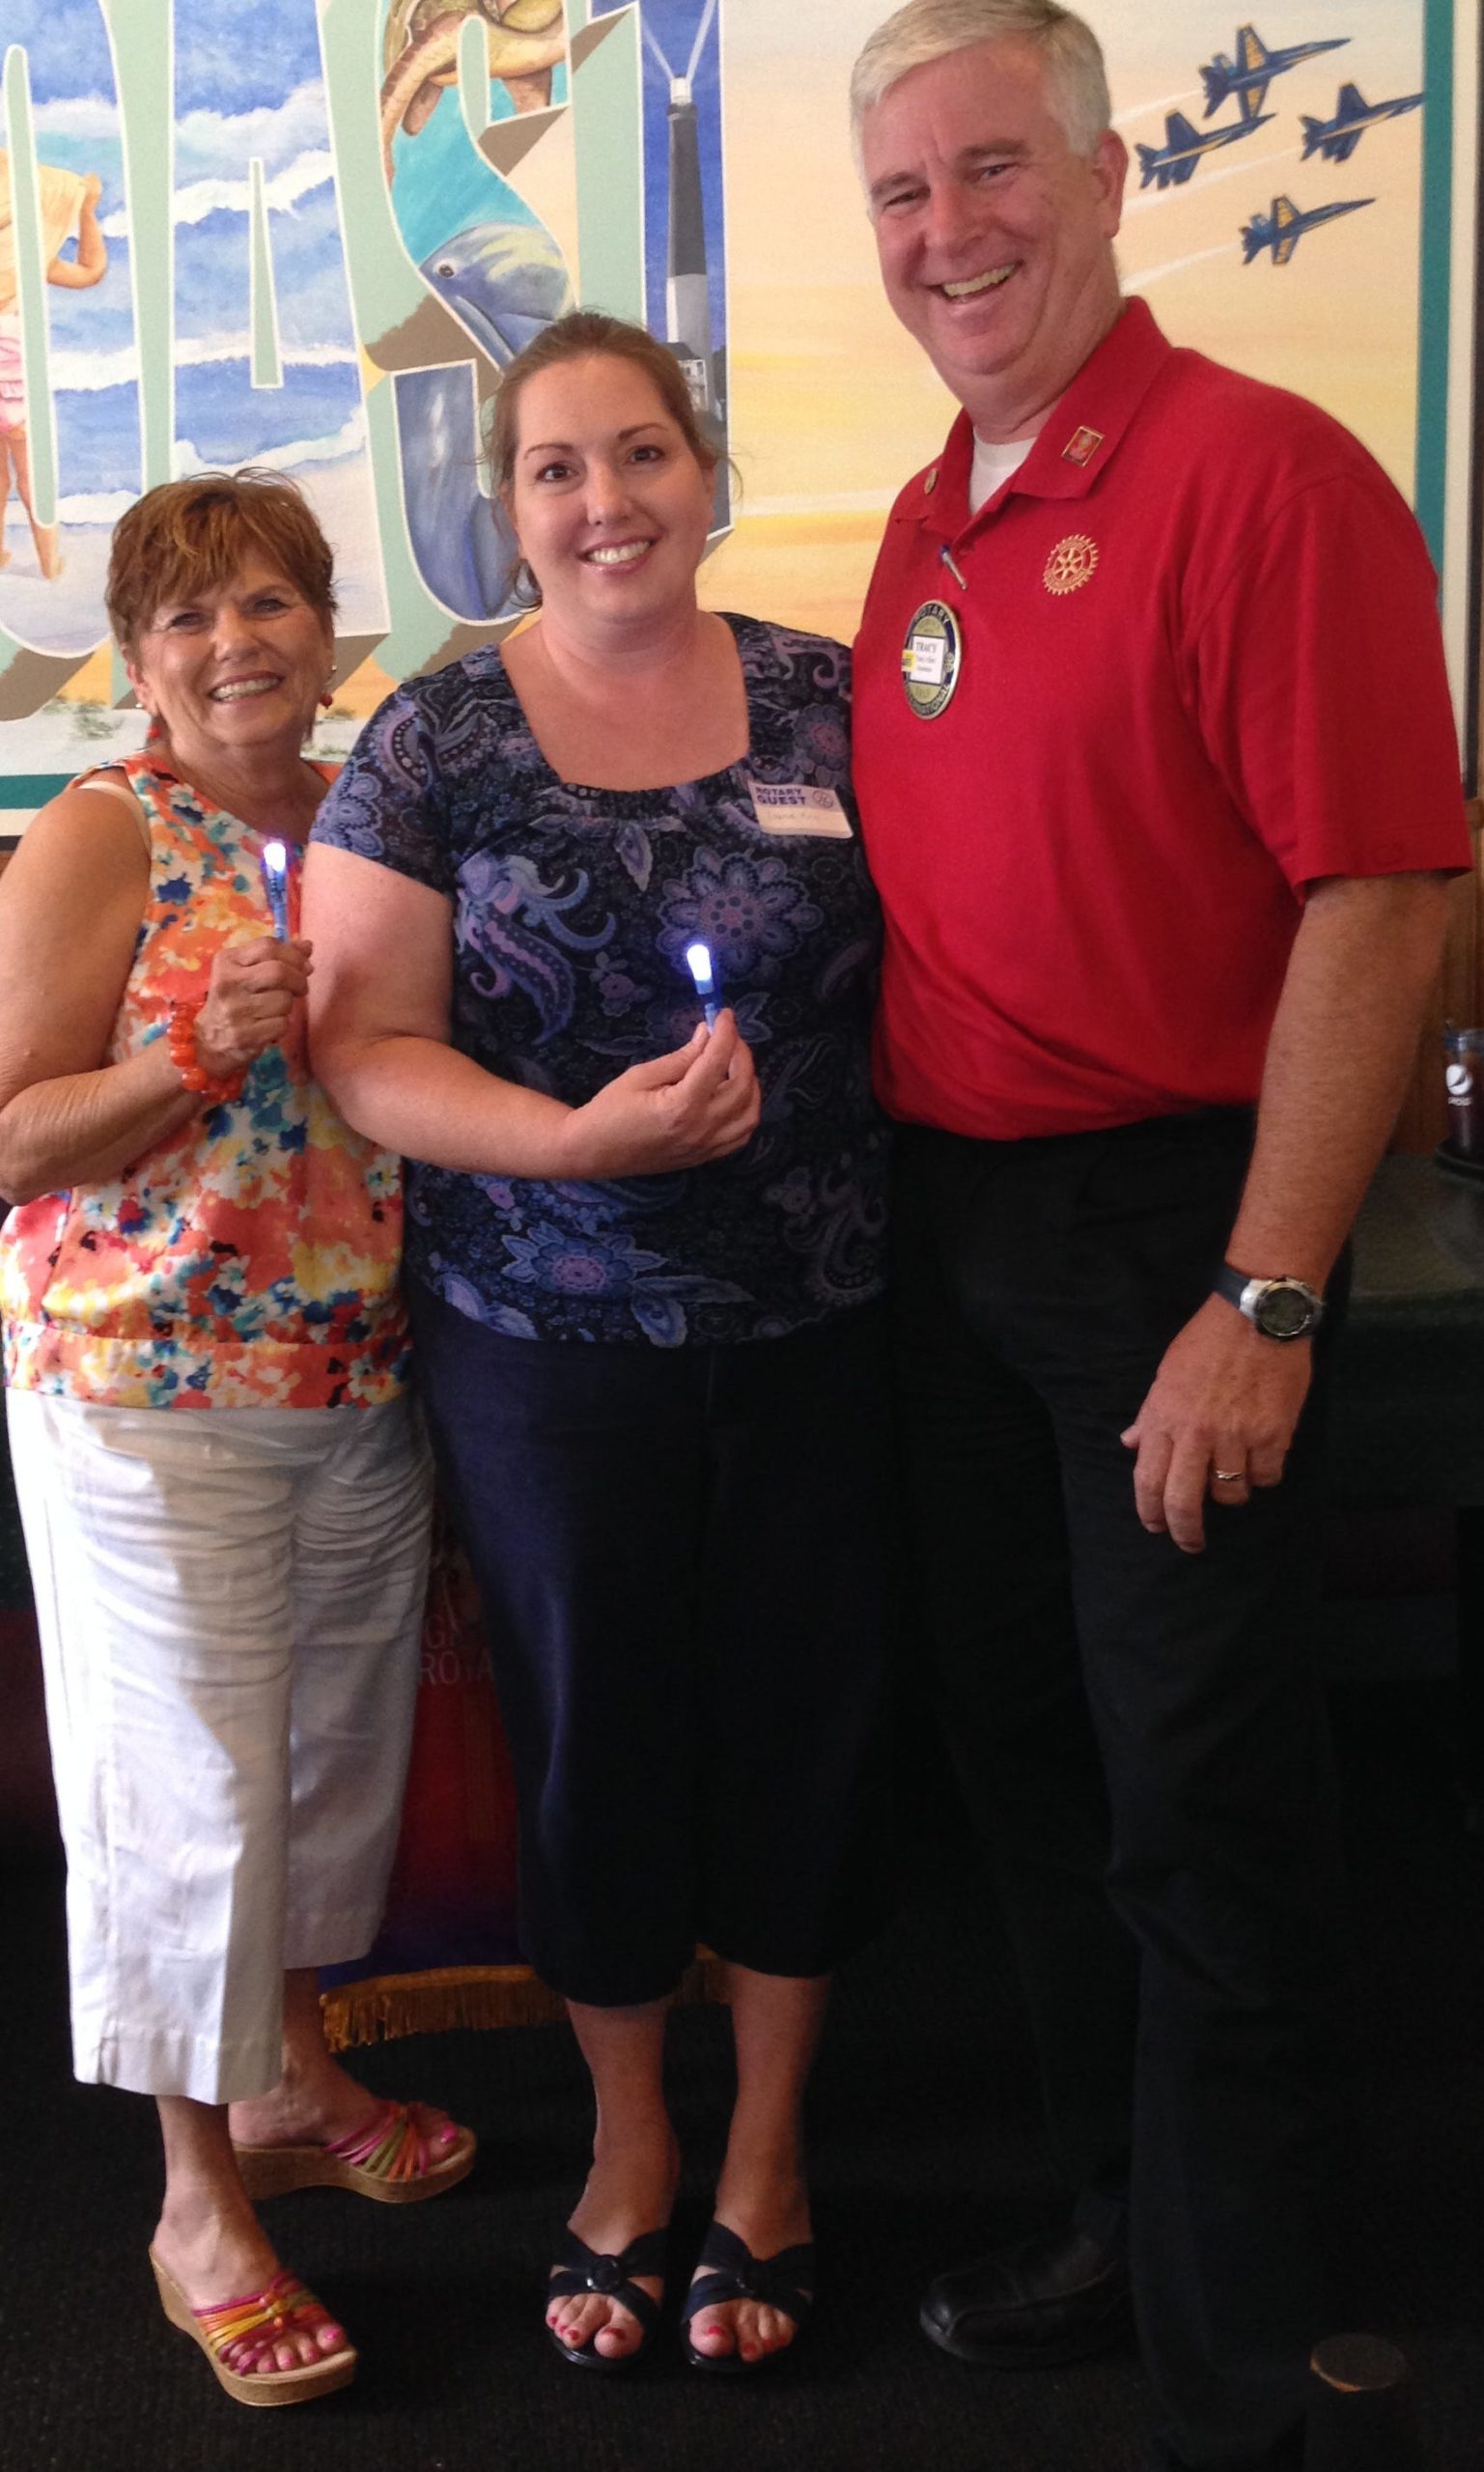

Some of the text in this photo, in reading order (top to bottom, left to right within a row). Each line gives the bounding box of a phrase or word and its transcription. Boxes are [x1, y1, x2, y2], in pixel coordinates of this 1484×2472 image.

[915, 641, 938, 654] TRACY
[755, 787, 802, 796] ROTARY
[757, 795, 806, 805] GUEST
